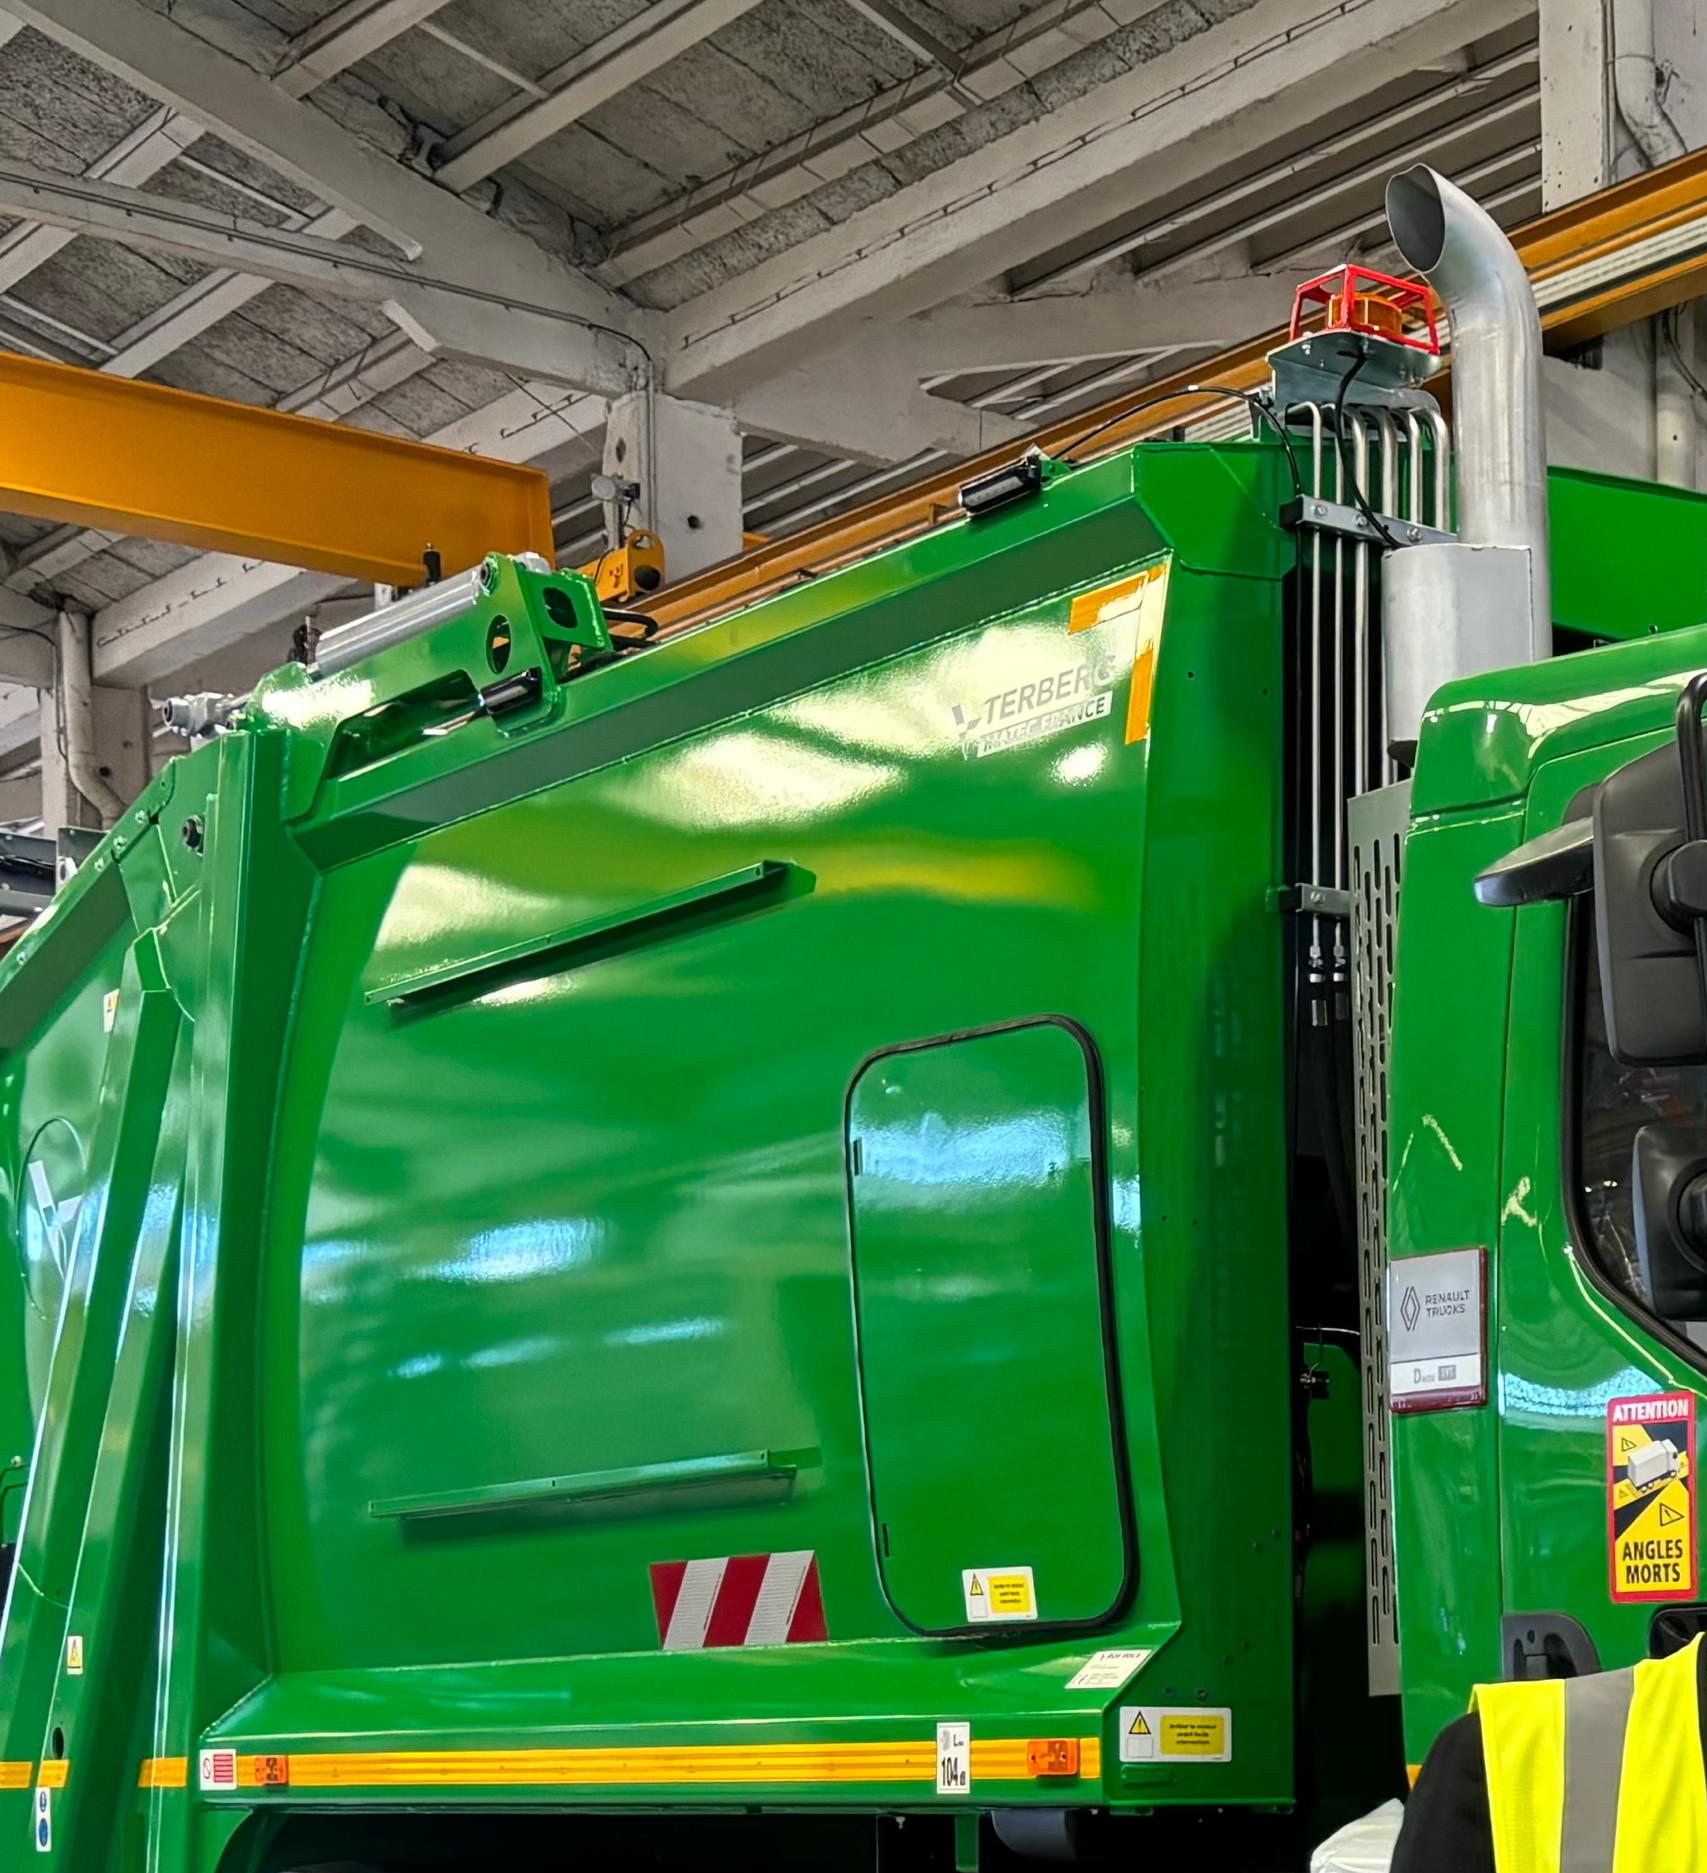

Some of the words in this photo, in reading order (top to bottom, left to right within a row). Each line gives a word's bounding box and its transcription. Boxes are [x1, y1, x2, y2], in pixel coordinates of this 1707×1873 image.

[984, 655, 1116, 725] TERBERG
[1425, 1289, 1471, 1305] RENAULT
[1426, 1303, 1466, 1318] TRUCKS
[1613, 1398, 1689, 1422] ATTENTION
[1622, 1539, 1683, 1561] ANGLES
[1626, 1563, 1681, 1584] MORTS
[941, 1756, 959, 1787] 104
